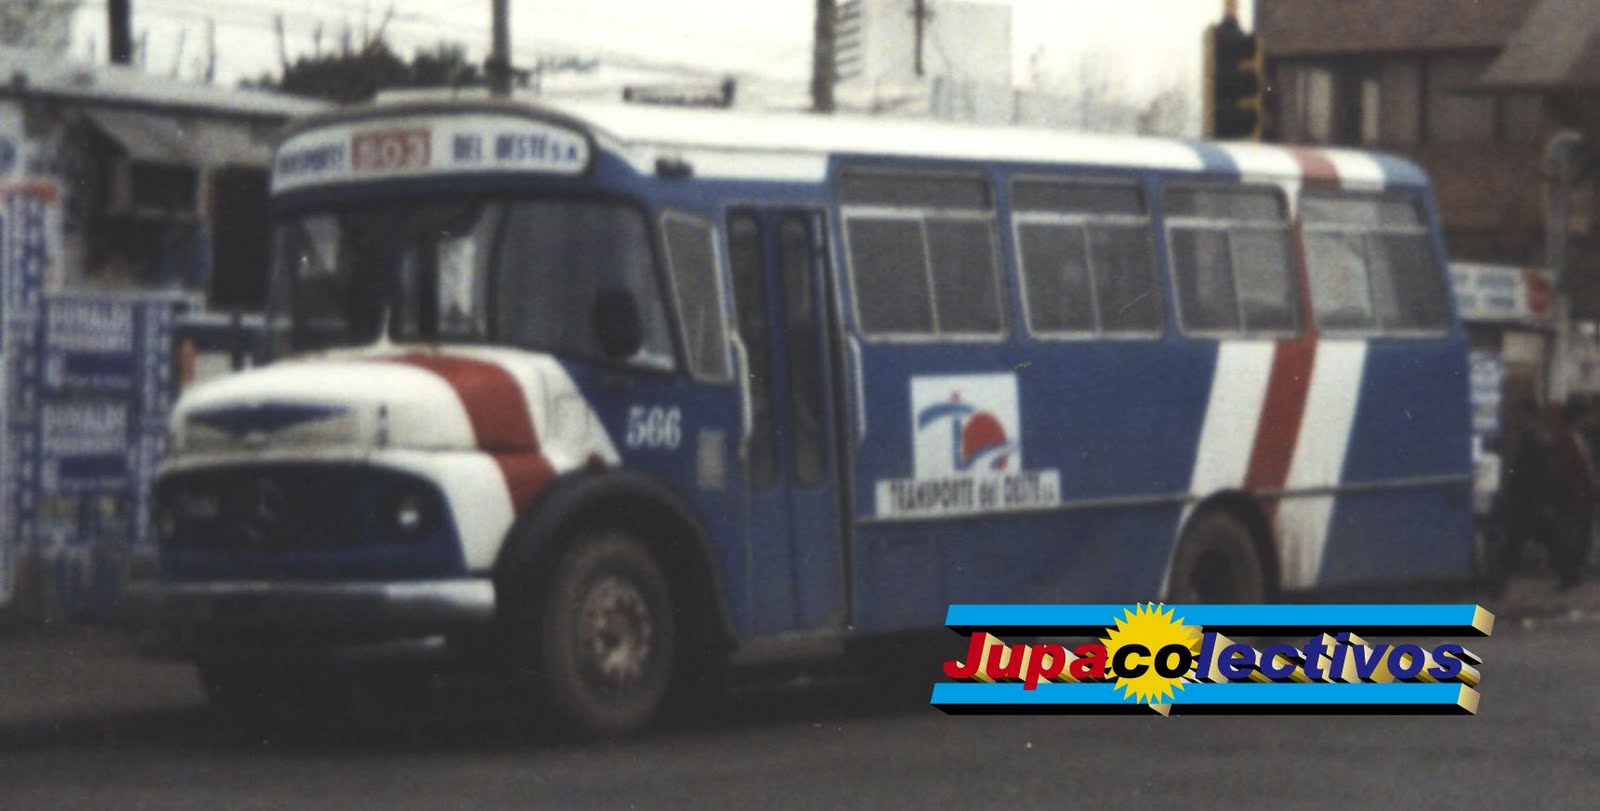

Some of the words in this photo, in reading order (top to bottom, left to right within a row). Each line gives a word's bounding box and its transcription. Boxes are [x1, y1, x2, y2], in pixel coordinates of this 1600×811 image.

[453, 135, 482, 160] DEL
[495, 134, 546, 159] OESTE
[627, 406, 681, 449] 566
[890, 477, 975, 509] TRANSPORTE
